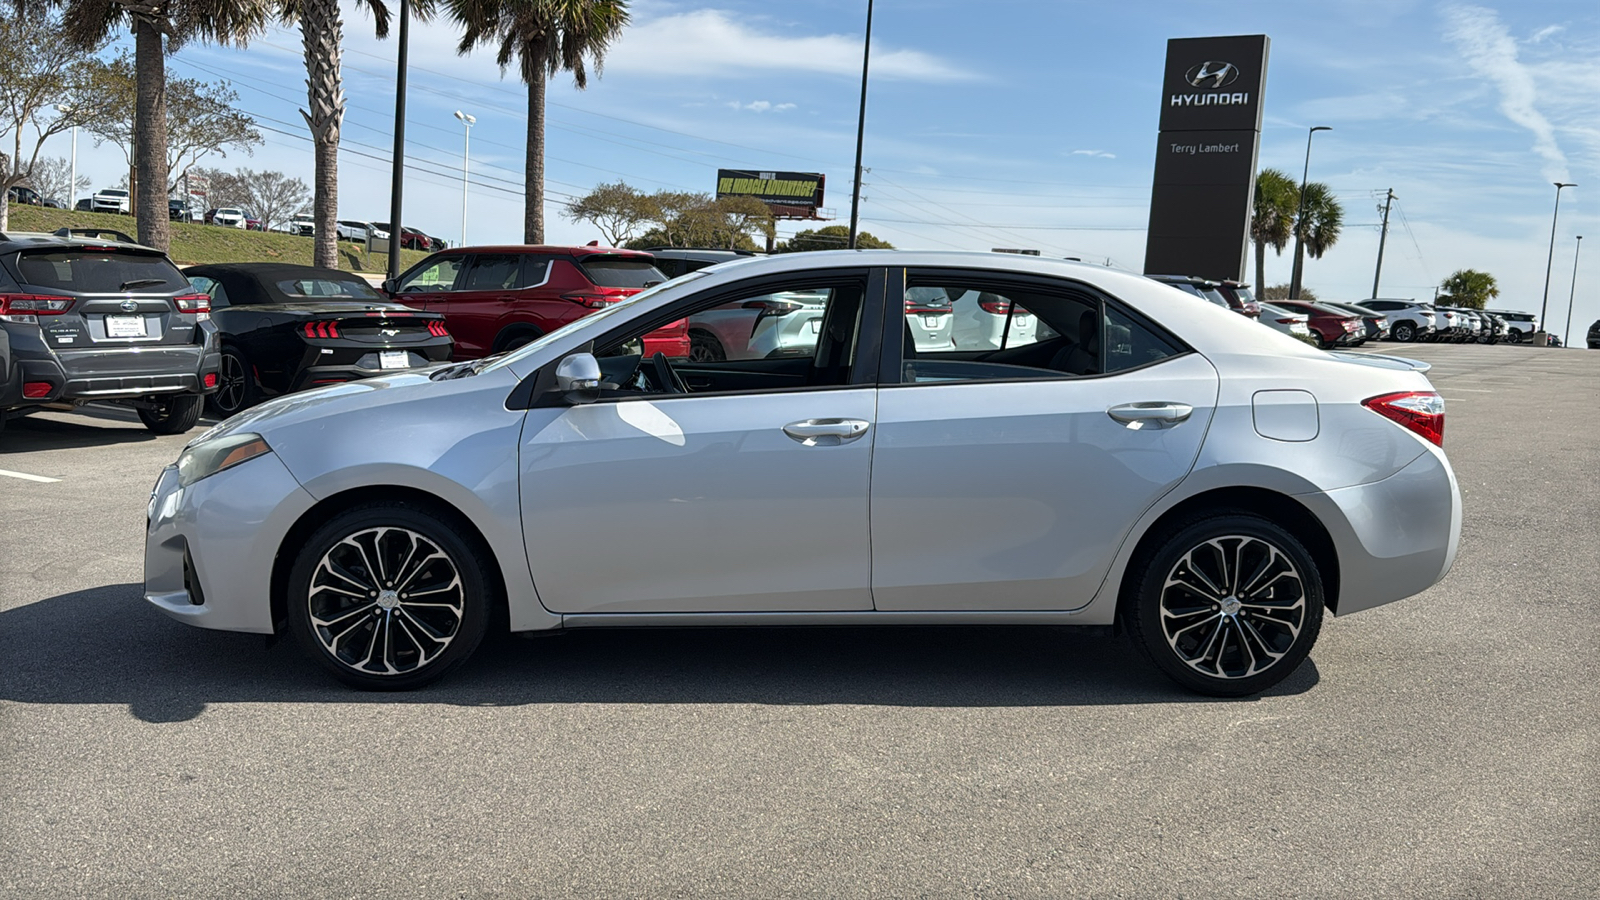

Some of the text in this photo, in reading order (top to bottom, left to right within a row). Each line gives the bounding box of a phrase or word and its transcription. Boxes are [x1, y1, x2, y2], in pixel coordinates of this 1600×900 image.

[1170, 92, 1249, 107] HYUNDAI
[1170, 143, 1240, 155] Terry Lambert
[718, 177, 818, 197] THE MIRACLE ADVANTAGE?
